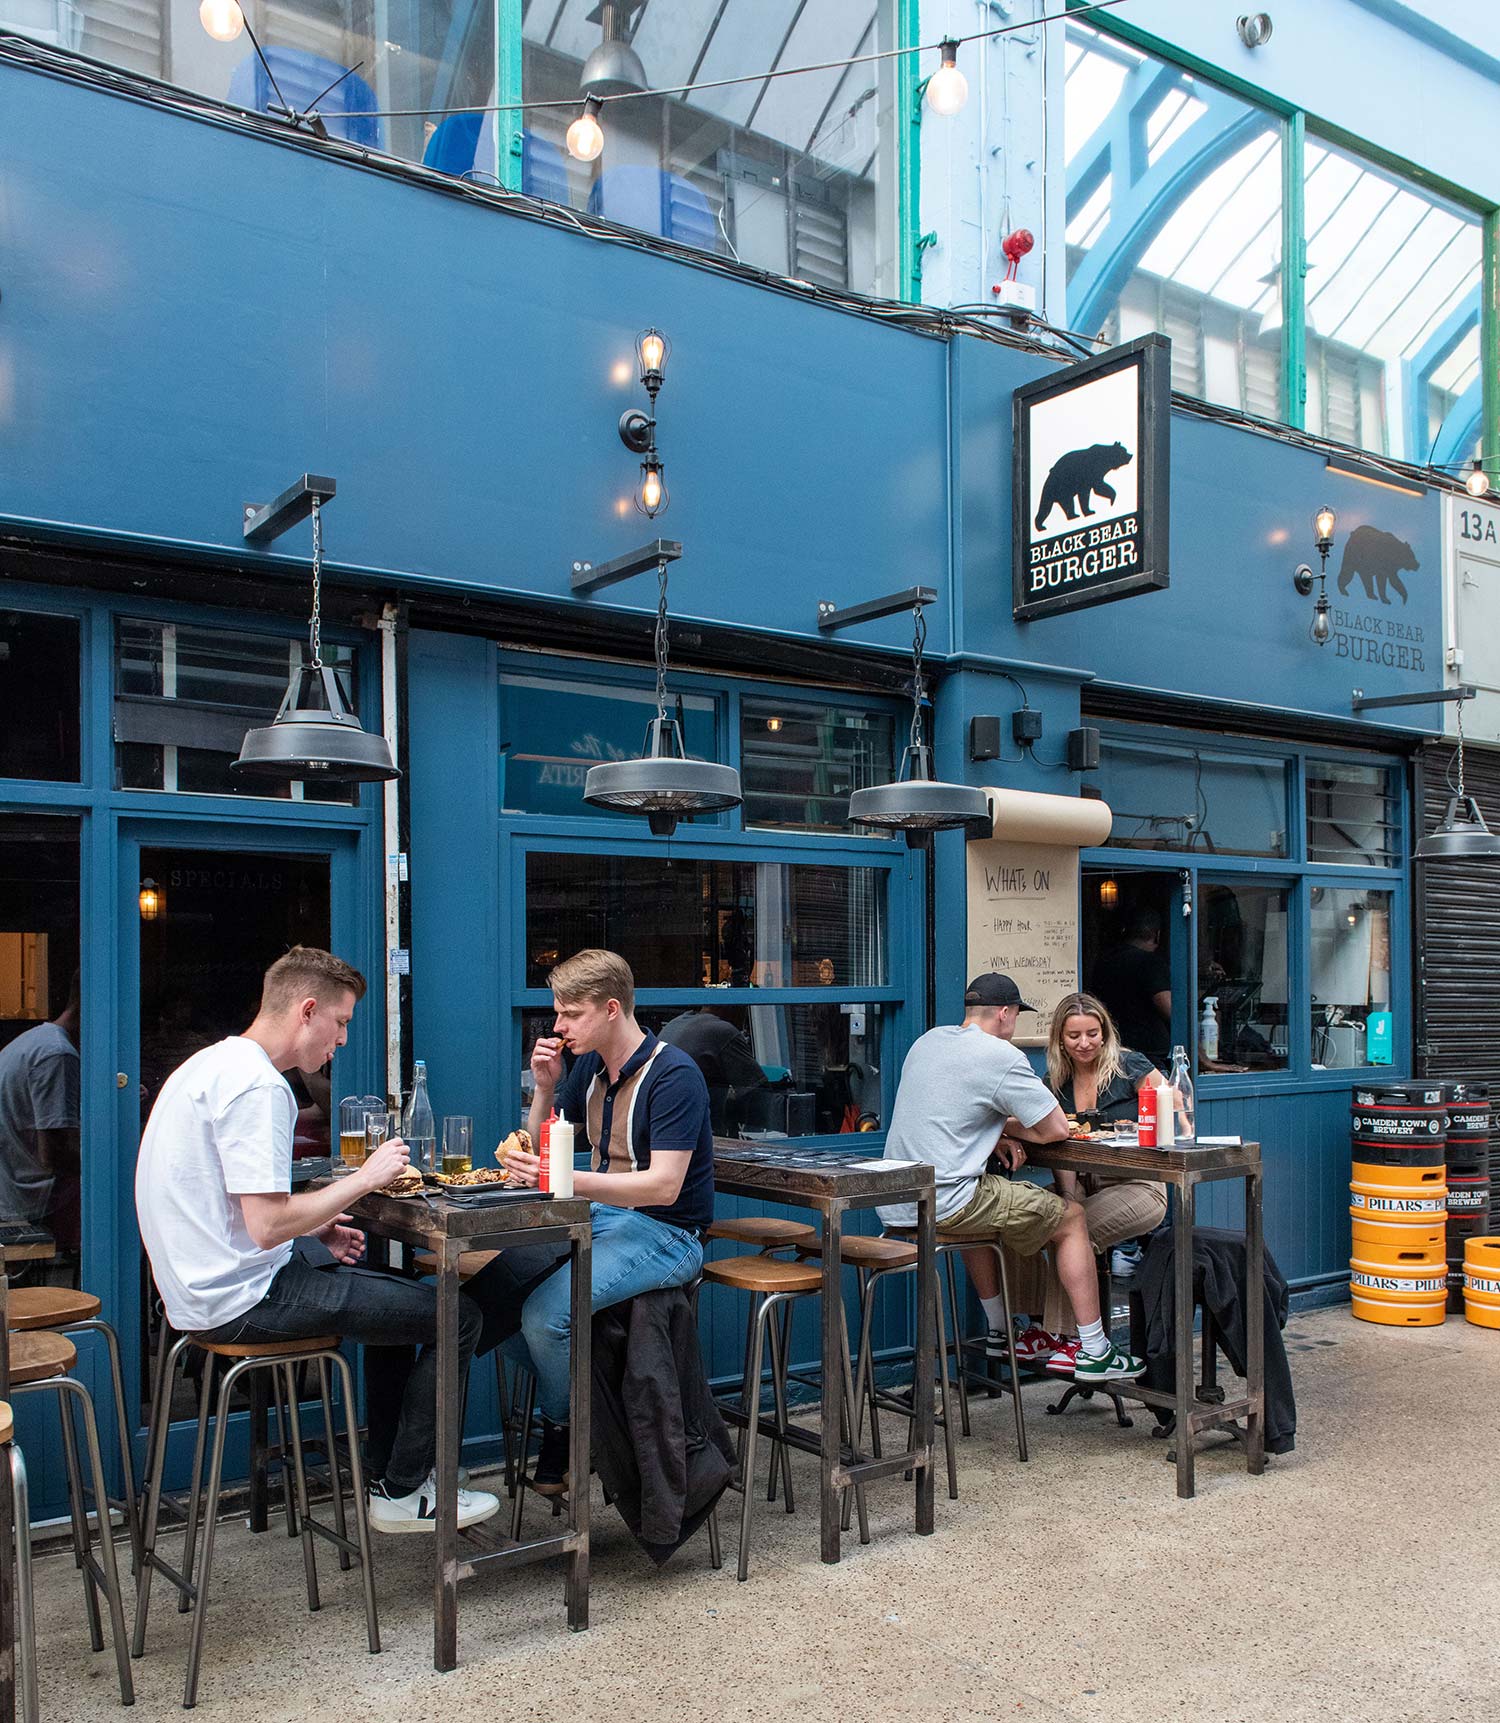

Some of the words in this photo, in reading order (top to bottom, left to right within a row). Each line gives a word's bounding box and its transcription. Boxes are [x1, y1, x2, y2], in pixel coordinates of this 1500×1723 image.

[1460, 510, 1497, 544] 13A
[1030, 533, 1086, 564] BLACK
[1089, 517, 1138, 547] BEAR
[1030, 540, 1138, 592] BURGER
[1334, 609, 1383, 635] BLACK
[1386, 621, 1425, 643] BEAR
[1334, 632, 1425, 672] BURGER
[170, 869, 284, 890] SPECIALS
[1033, 870, 1050, 891] ON
[993, 918, 1013, 933] HAPPY
[1362, 1118, 1398, 1127] CAMDEN
[1373, 1126, 1414, 1134] BREWERY
[1369, 1198, 1423, 1211] PILLARS
[1354, 1272, 1399, 1290] PILLARS
[1471, 1278, 1500, 1293] PILLA
